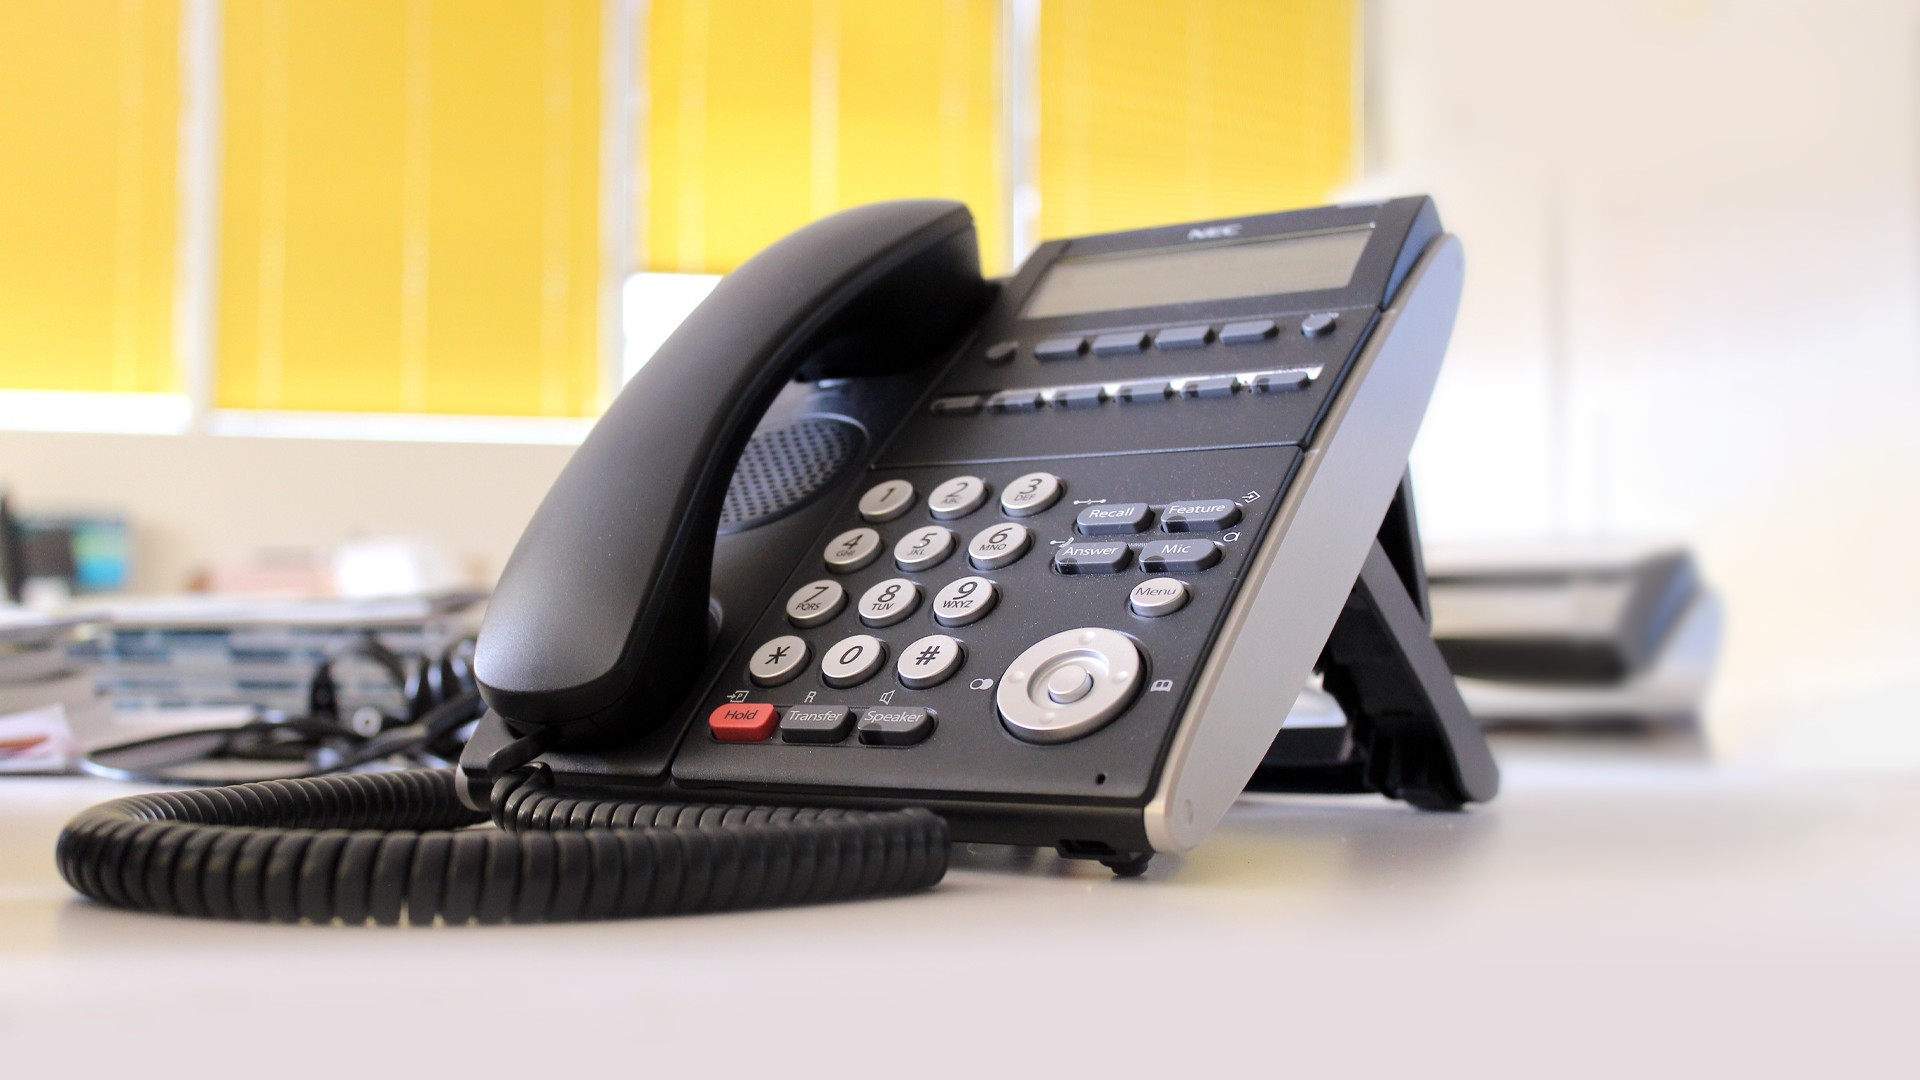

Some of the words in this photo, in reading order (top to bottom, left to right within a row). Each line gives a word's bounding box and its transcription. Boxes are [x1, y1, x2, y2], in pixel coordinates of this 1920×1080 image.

[946, 482, 968, 498] 2
[1019, 479, 1042, 494] 3
[881, 487, 896, 502] 1
[1089, 507, 1135, 519] Recall
[1168, 504, 1226, 515] Feature
[842, 534, 864, 549] 4
[913, 533, 937, 548] 5
[989, 527, 1013, 544] 6
[1062, 545, 1119, 556] Answer
[1161, 543, 1191, 554] Mic
[803, 586, 829, 603] 7
[877, 584, 901, 603] 8
[952, 581, 978, 600] 9
[1135, 587, 1177, 596] Menu
[795, 603, 821, 611] PQRS
[871, 603, 895, 611] TUV
[942, 600, 973, 609] WXYZ
[915, 645, 940, 665] #
[804, 690, 817, 703] R
[724, 709, 758, 720] Hold
[789, 710, 843, 722] Transfer
[864, 710, 924, 724] Speaker
